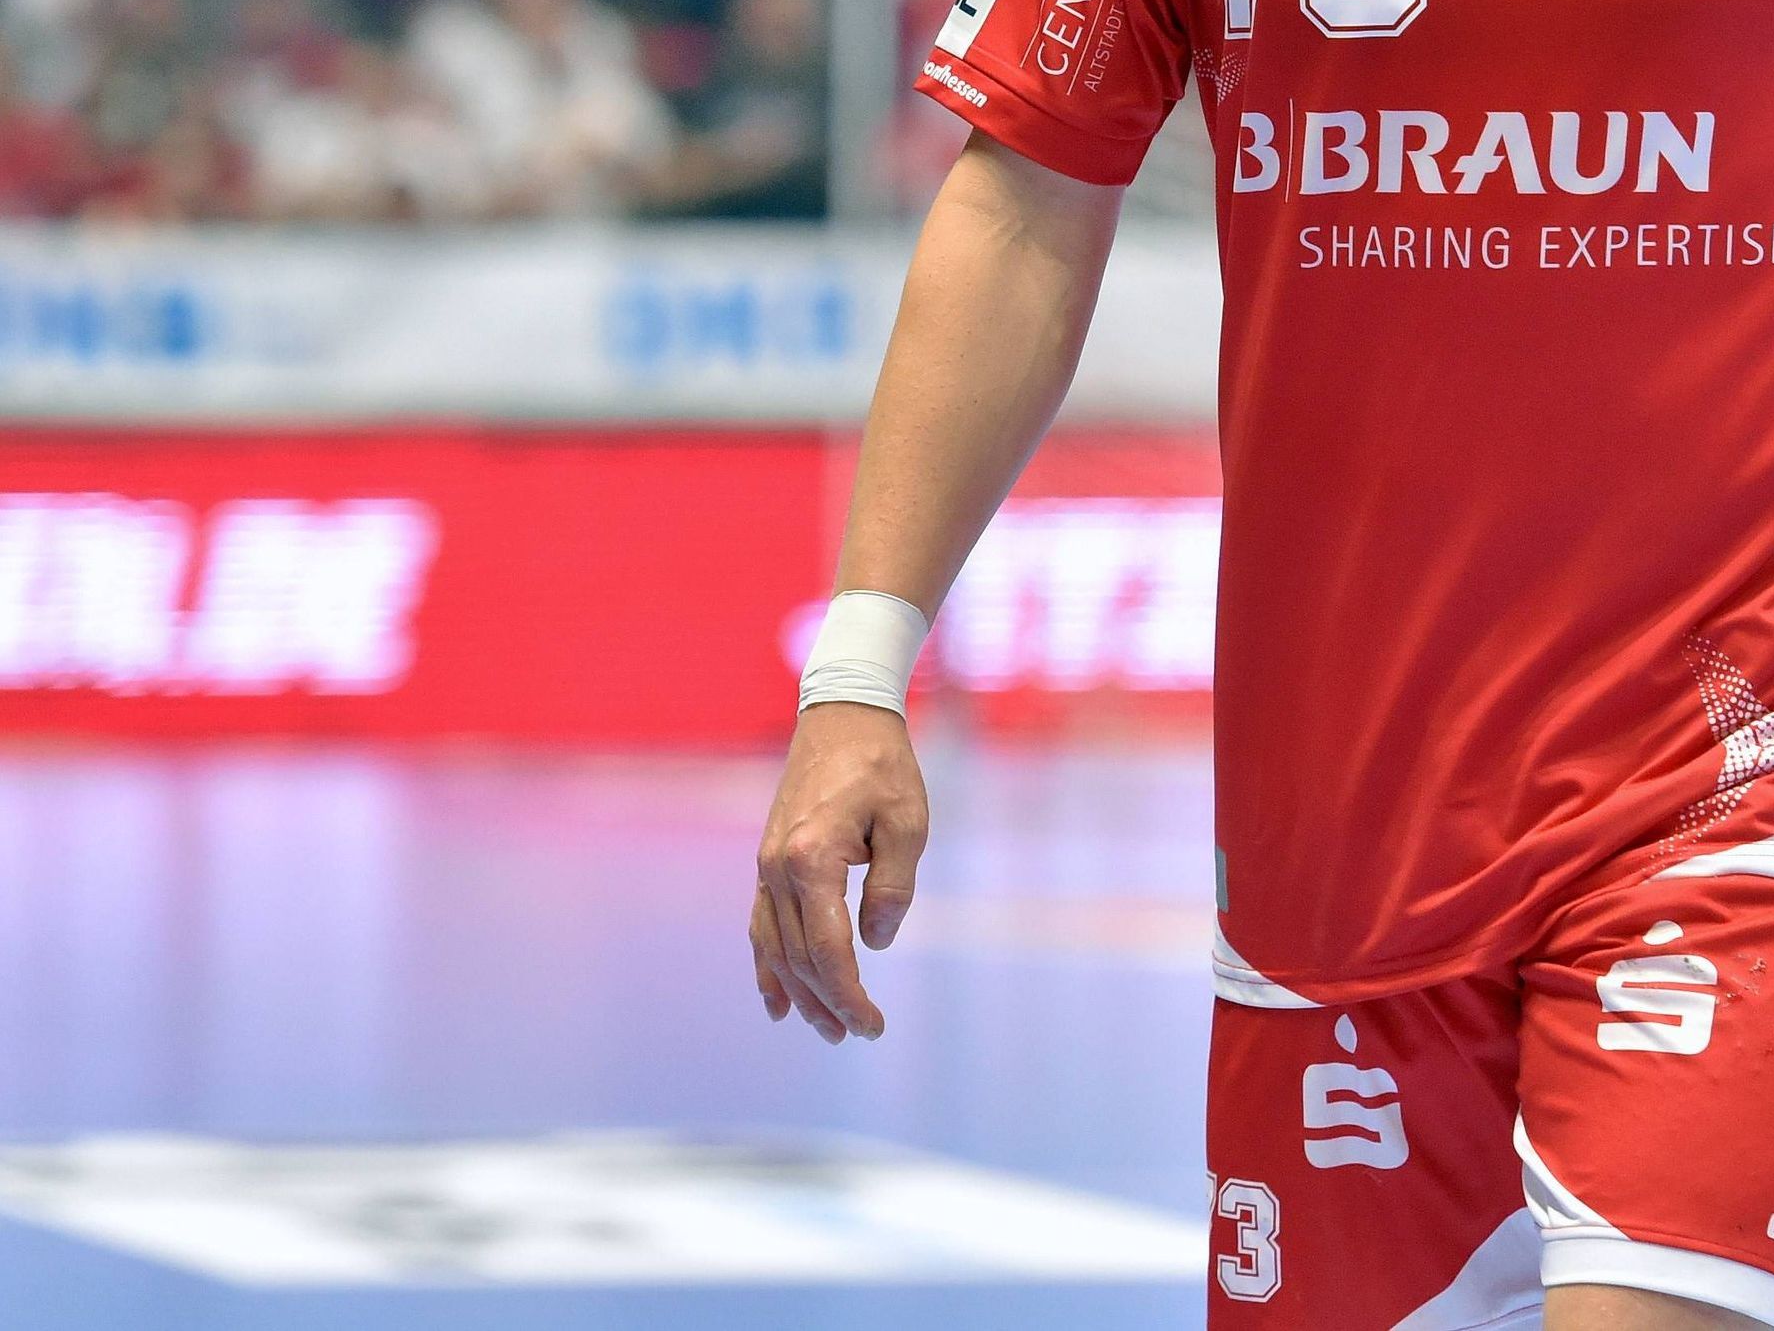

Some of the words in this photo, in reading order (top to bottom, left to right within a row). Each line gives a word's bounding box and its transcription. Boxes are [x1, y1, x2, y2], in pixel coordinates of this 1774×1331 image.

[1299, 110, 1716, 195] BRAUN
[1299, 225, 1511, 269] SHARING
[1206, 1169, 1282, 1303] 3
